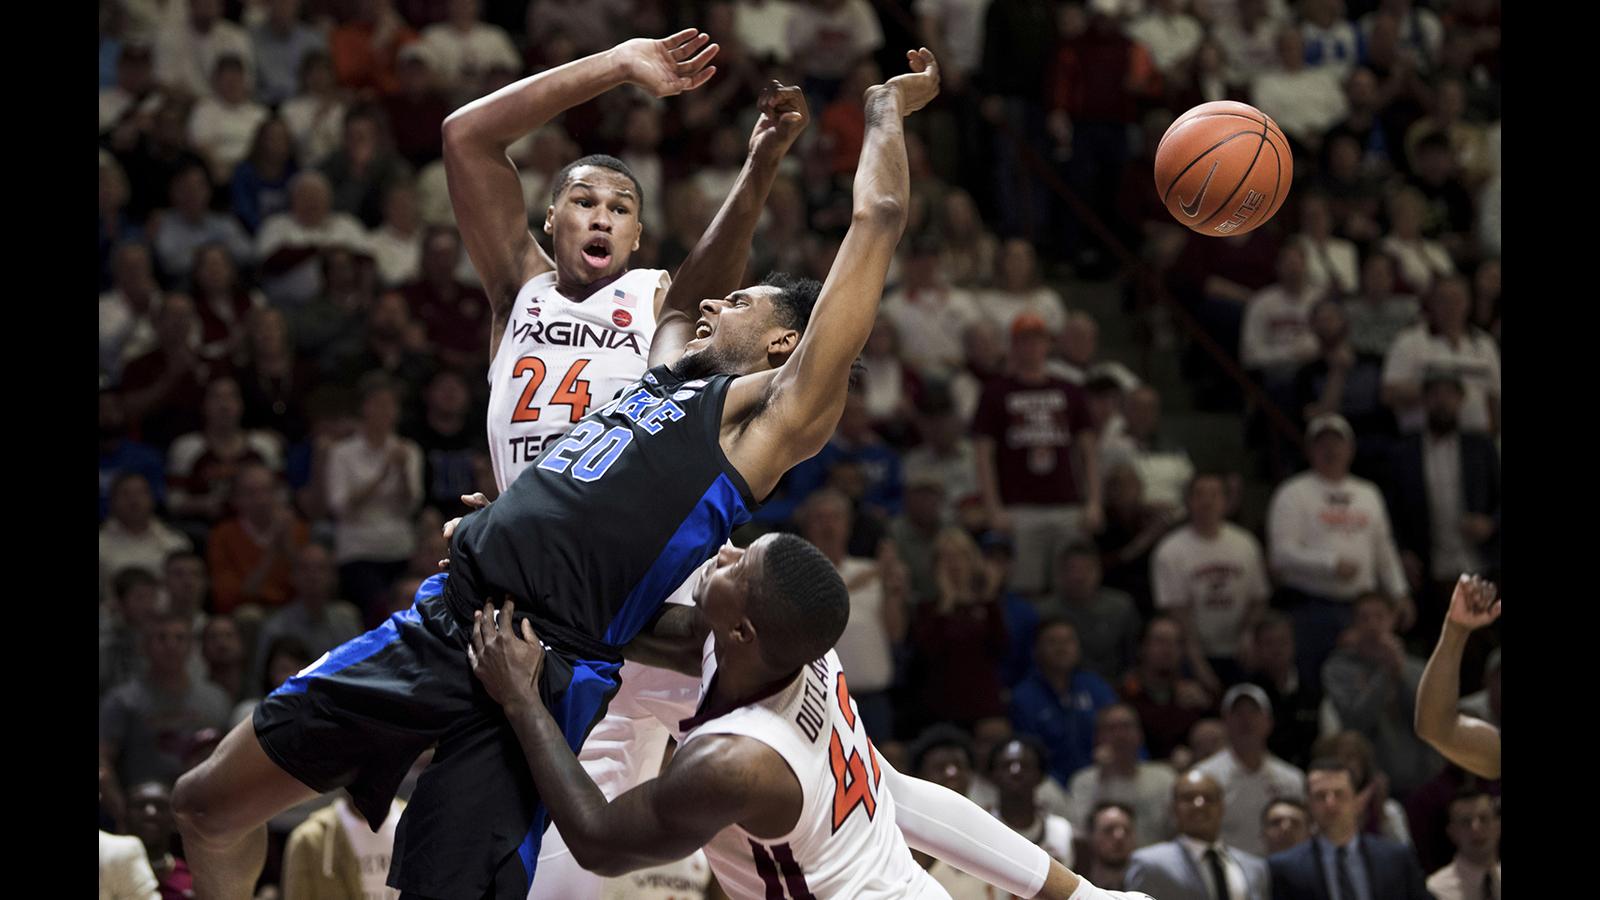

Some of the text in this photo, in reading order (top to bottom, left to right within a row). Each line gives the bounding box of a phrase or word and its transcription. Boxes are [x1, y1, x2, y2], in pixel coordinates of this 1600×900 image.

[1215, 190, 1263, 234] ELITE
[512, 319, 642, 356] VIRGINIA
[510, 356, 592, 424] 24
[602, 382, 686, 436] KE
[537, 420, 634, 483] 20
